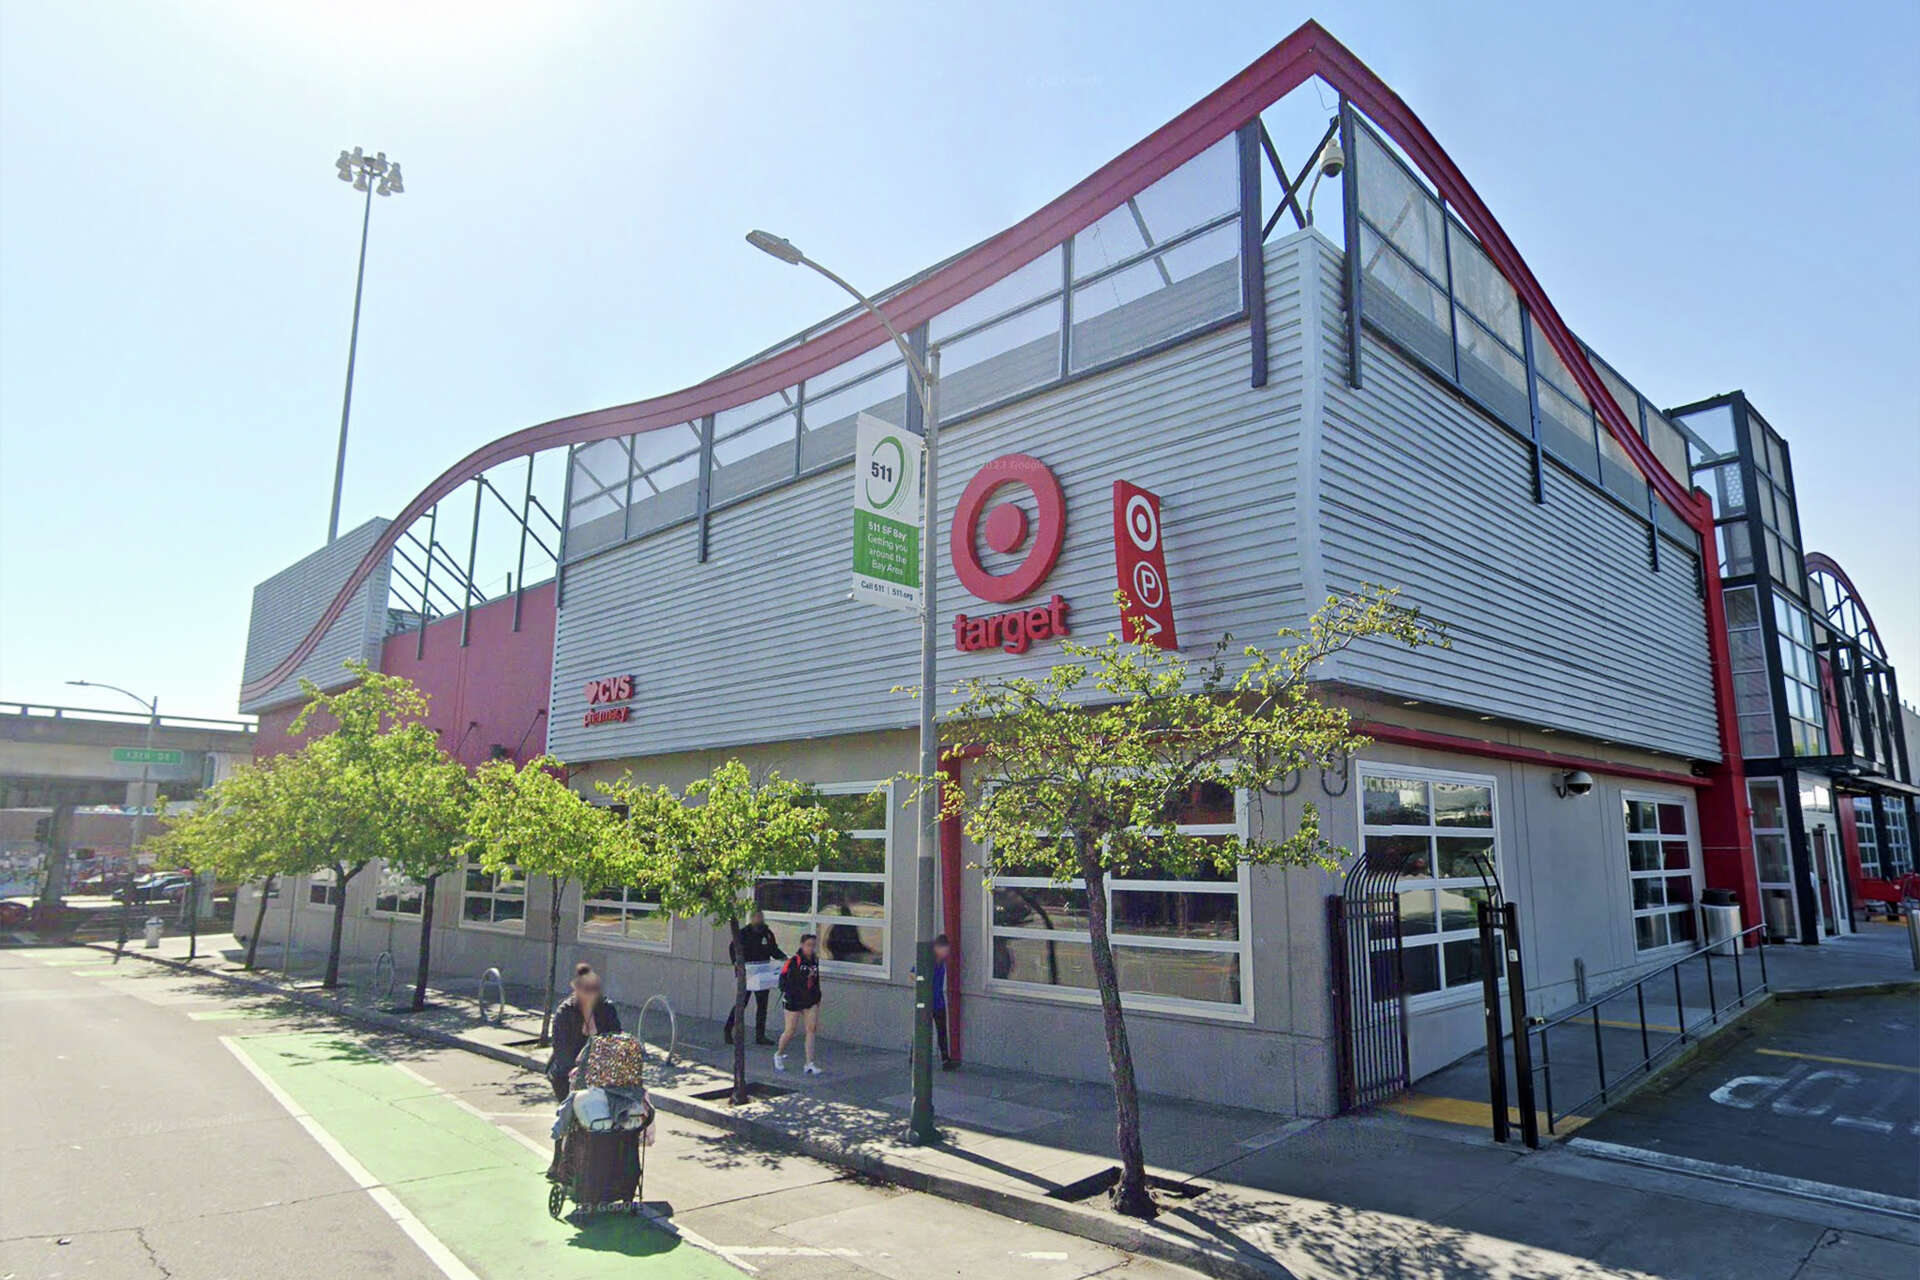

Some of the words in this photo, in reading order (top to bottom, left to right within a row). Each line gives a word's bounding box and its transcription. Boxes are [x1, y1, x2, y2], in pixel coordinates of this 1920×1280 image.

[871, 461, 892, 482] 511
[868, 521, 880, 532] 511
[893, 529, 907, 541] Bay
[868, 533, 894, 550] Getting
[895, 543, 908, 553] you
[869, 548, 894, 560] around
[896, 555, 907, 564] the
[872, 559, 886, 571] Bay
[887, 564, 904, 575] Area
[861, 580, 873, 590] Call
[874, 583, 884, 592] 511
[952, 594, 1070, 654] target
[598, 674, 634, 702] CVS
